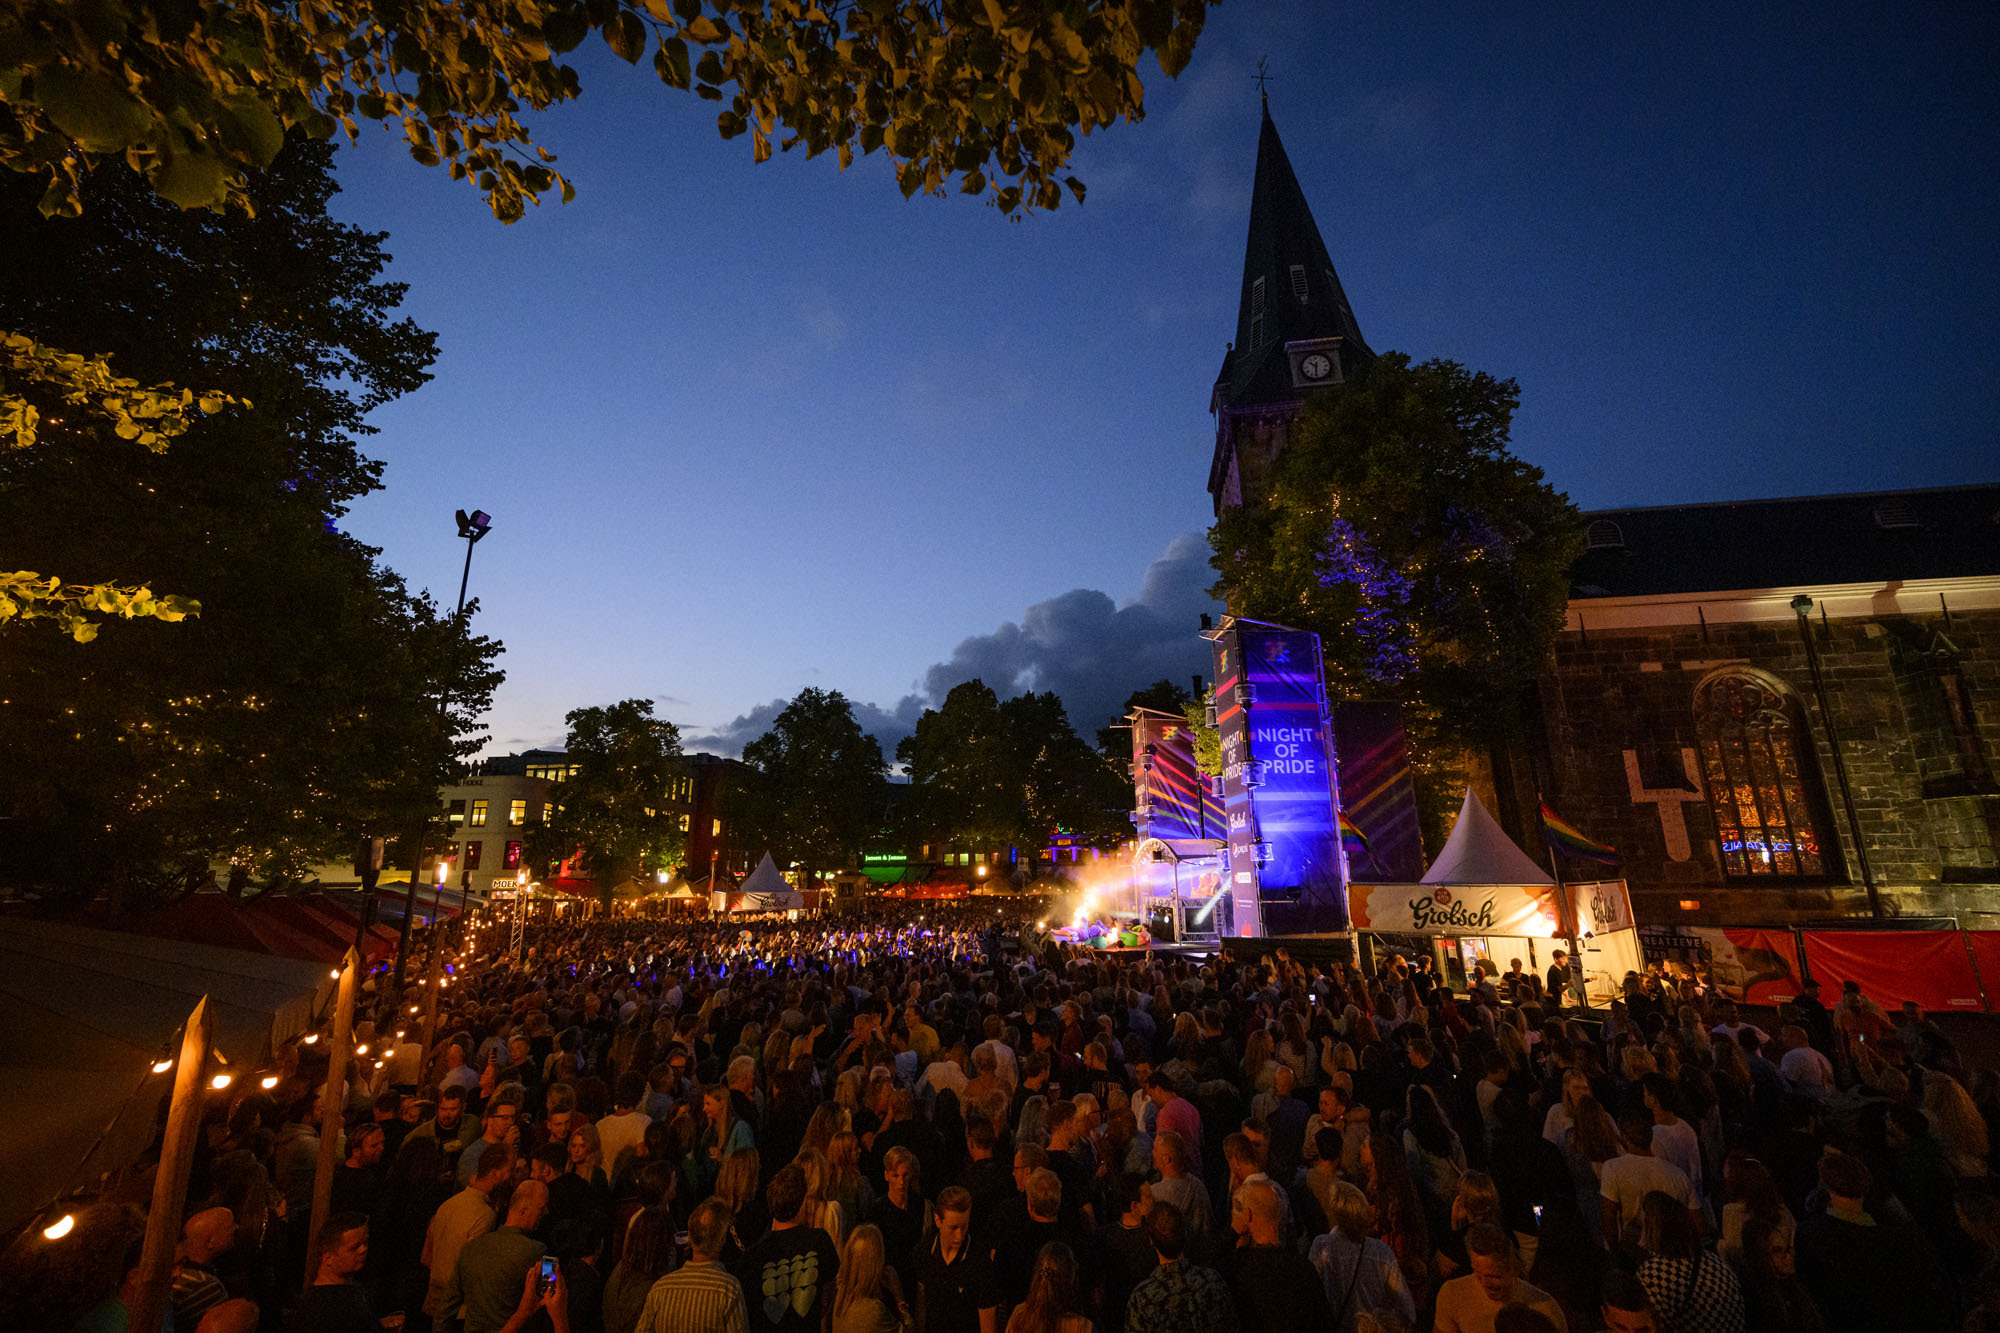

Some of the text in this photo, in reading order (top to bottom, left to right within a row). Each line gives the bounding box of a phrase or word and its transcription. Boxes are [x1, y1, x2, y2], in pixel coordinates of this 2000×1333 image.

[1223, 731, 1240, 751] NIGHT
[1258, 728, 1313, 742] NIGHT
[1228, 749, 1236, 764] OF
[1275, 744, 1299, 757] OF
[1225, 762, 1242, 780] PRIDE
[1263, 760, 1315, 774] PRIDE
[1409, 897, 1495, 929] Grolsch
[1644, 936, 1701, 948] REATIEVE
